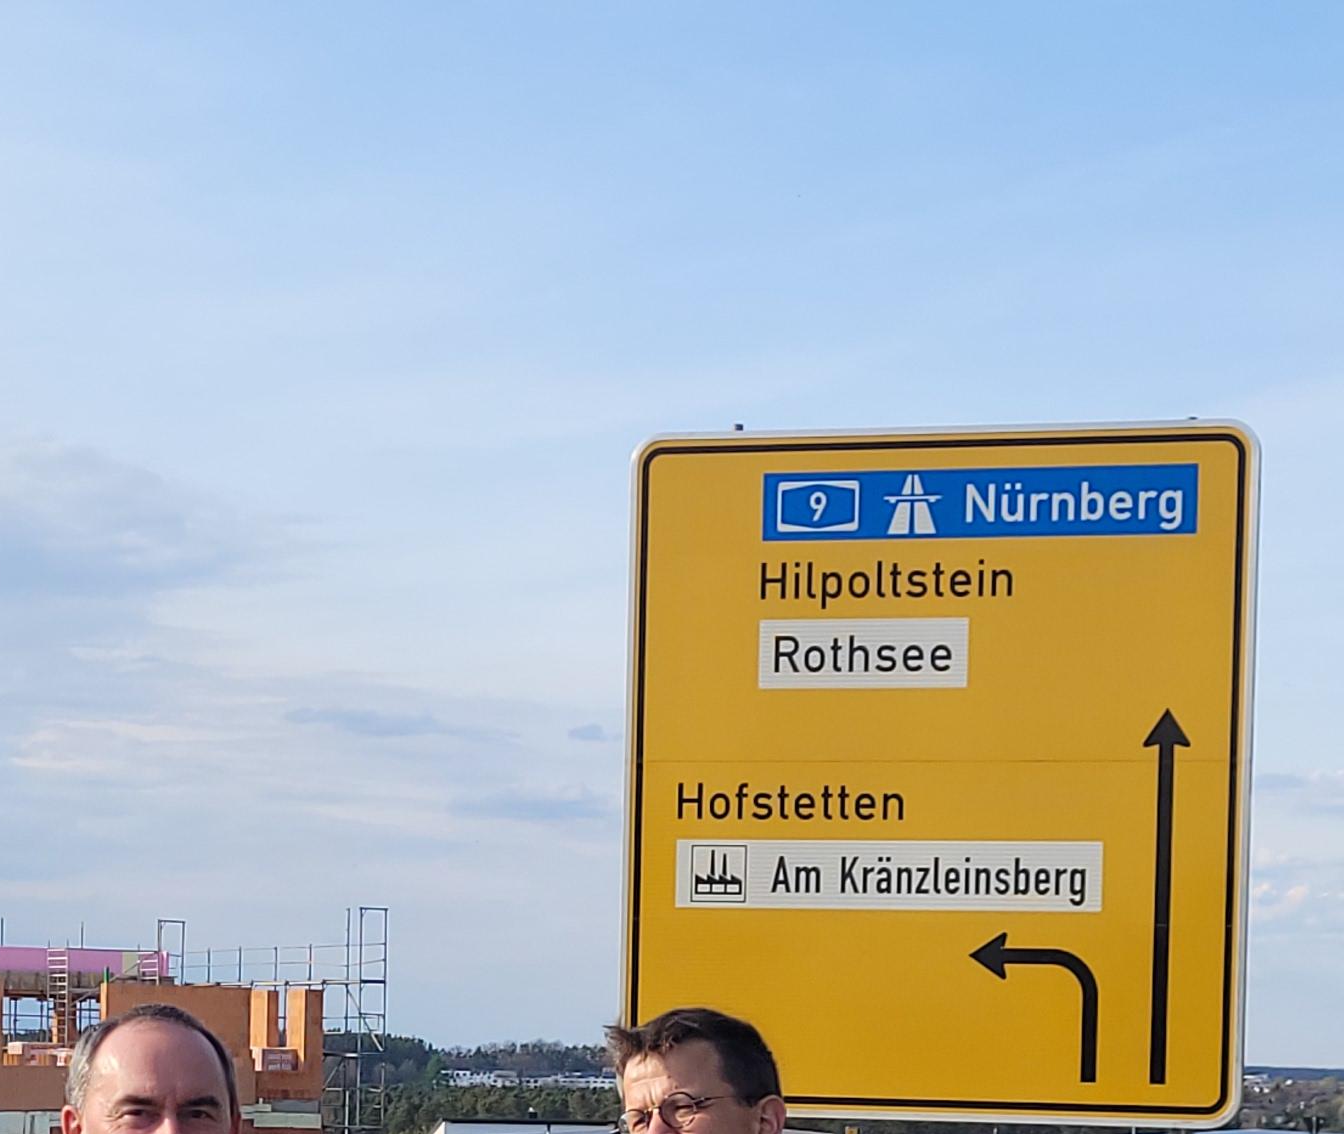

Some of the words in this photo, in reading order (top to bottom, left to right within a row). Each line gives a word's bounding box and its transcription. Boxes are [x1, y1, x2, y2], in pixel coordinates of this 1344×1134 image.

[809, 491, 827, 521] 9
[964, 481, 1184, 530] Nürnberg
[759, 559, 1014, 609] Hilpoltstein
[773, 635, 953, 673] Rothsee
[677, 782, 905, 820] Hofstetten
[771, 855, 821, 894] Am
[840, 856, 1087, 906] Kränzleinsberg
